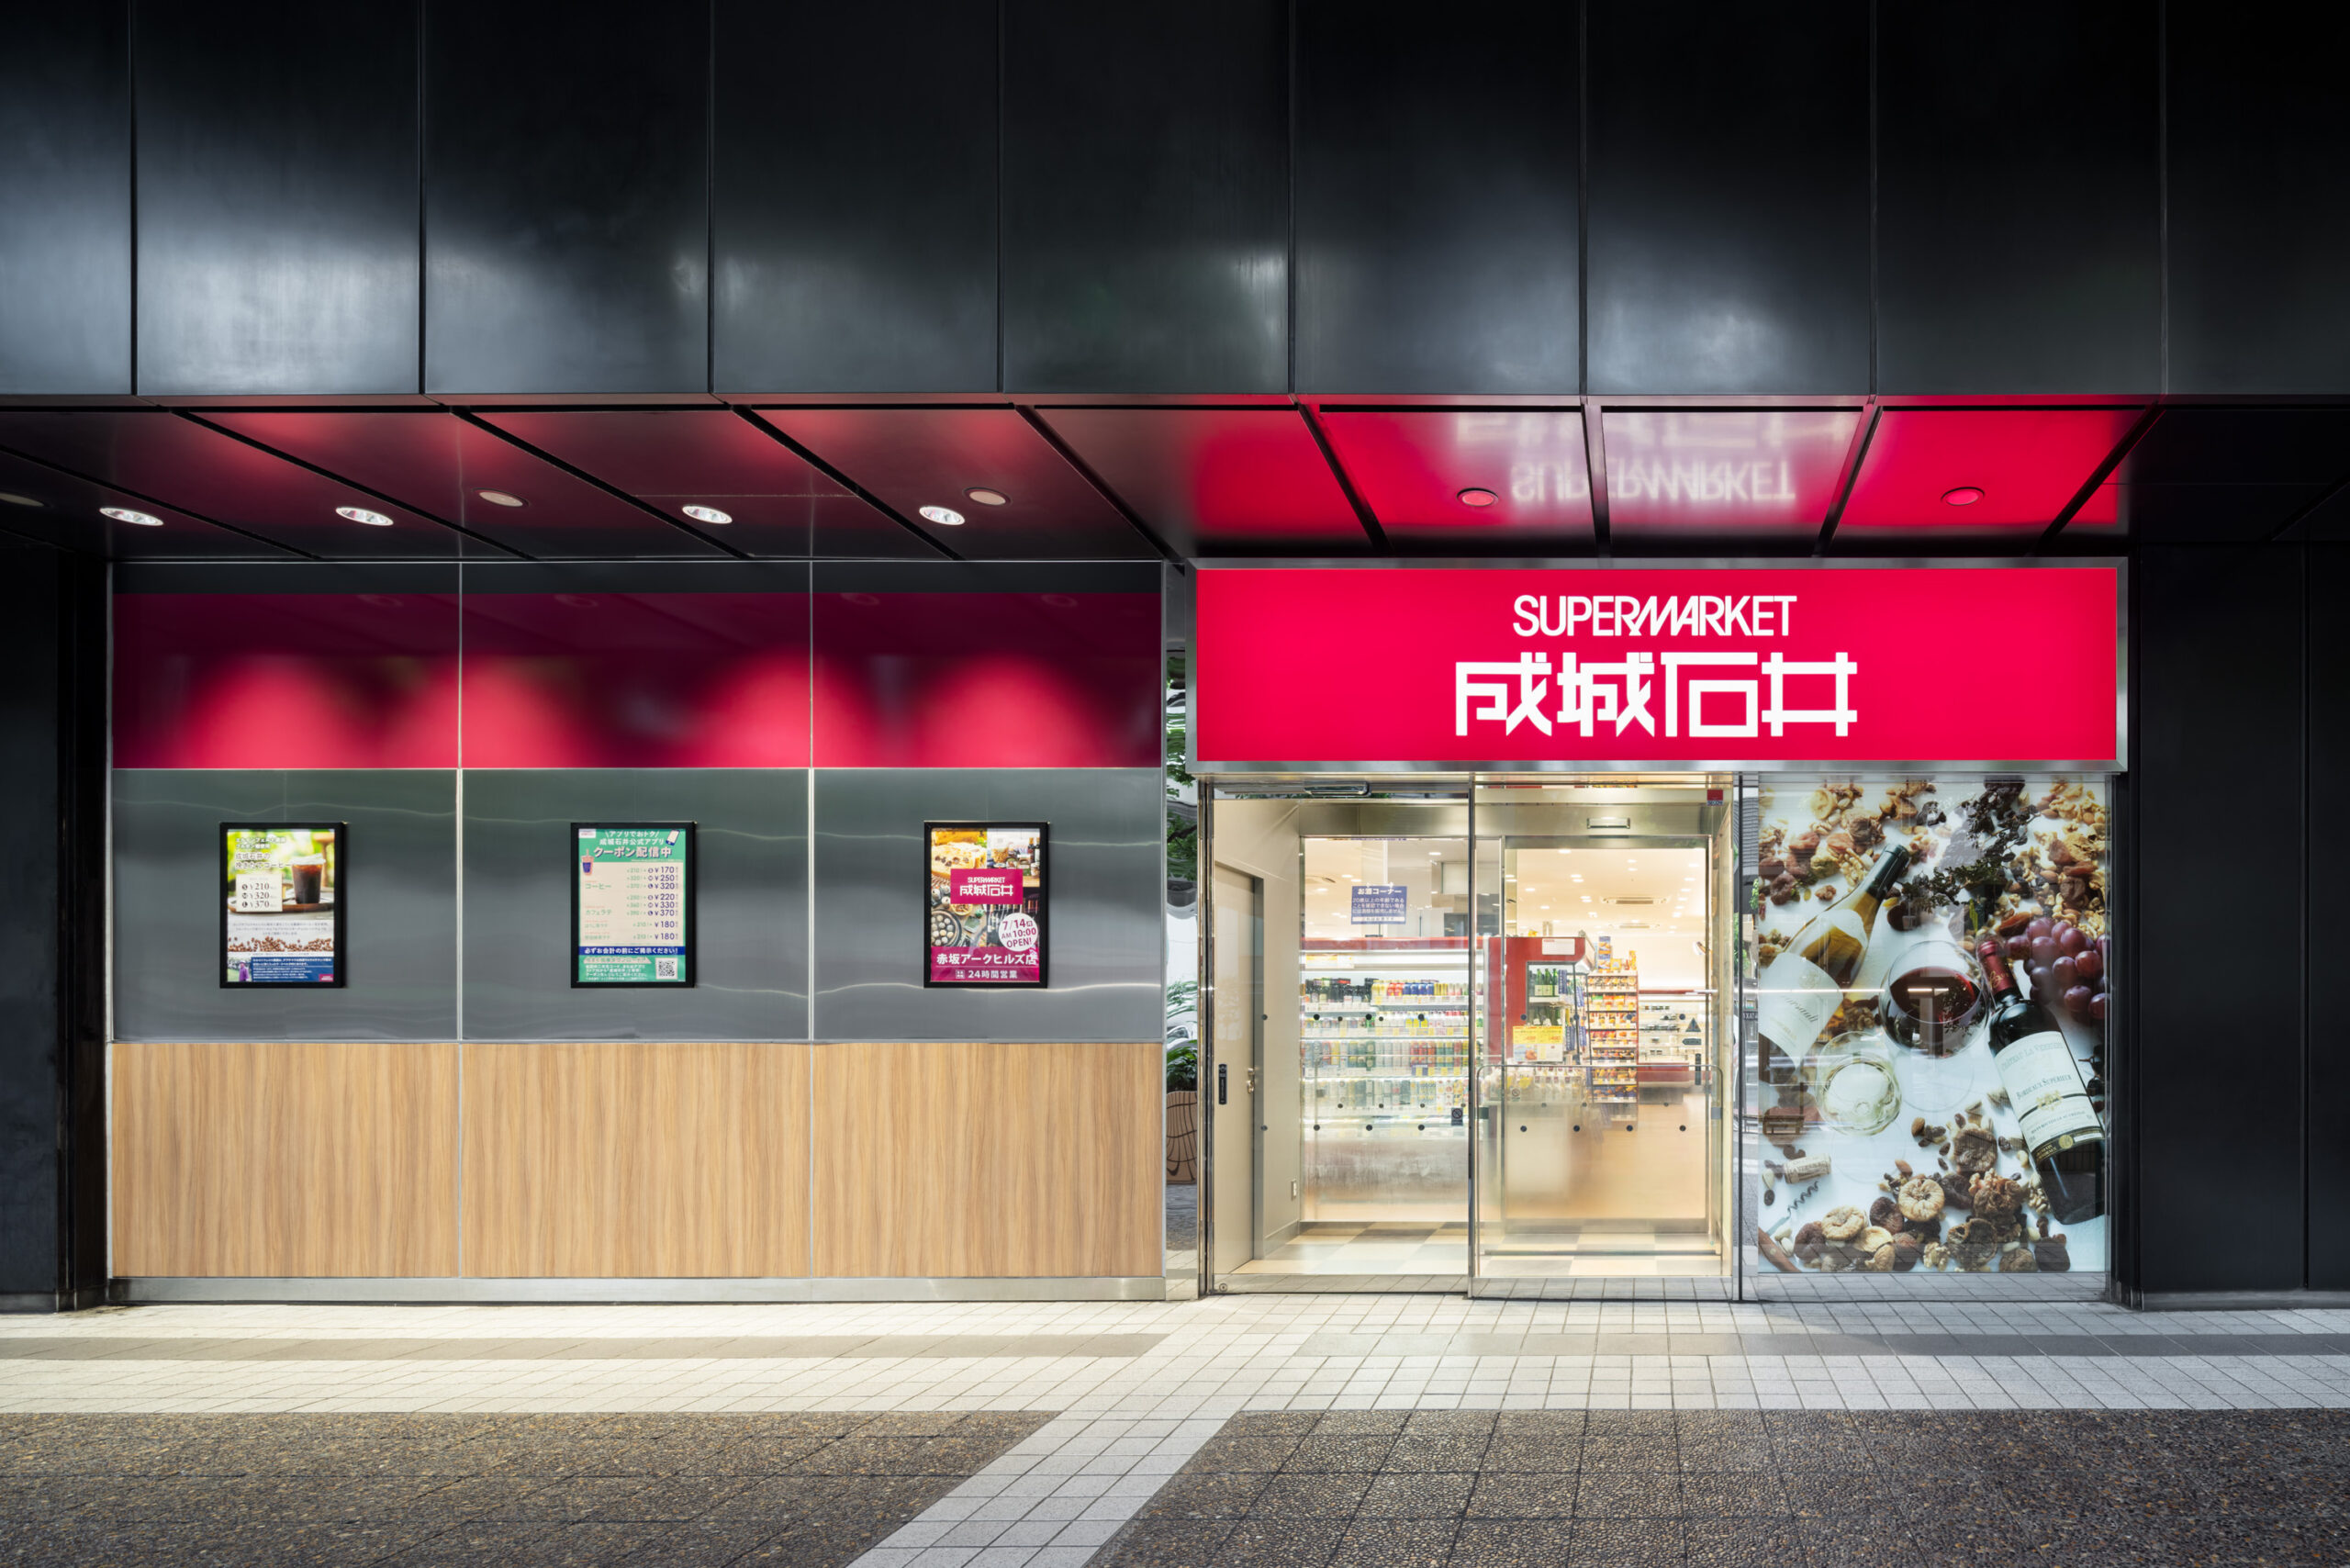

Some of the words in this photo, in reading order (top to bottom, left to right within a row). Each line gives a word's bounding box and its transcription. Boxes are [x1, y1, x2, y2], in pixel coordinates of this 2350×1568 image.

[1513, 595, 1797, 637] SUPERMARKET
[1456, 652, 1857, 737] 成城石井
[593, 846, 673, 858] クーポン配信中
[960, 884, 1013, 896] 成城石井
[1013, 927, 1036, 938] 10:00
[1006, 936, 1032, 947] OPEN!
[936, 953, 1037, 965] 赤坂アークヒルズ店
[968, 969, 1017, 979] 24時間営業
